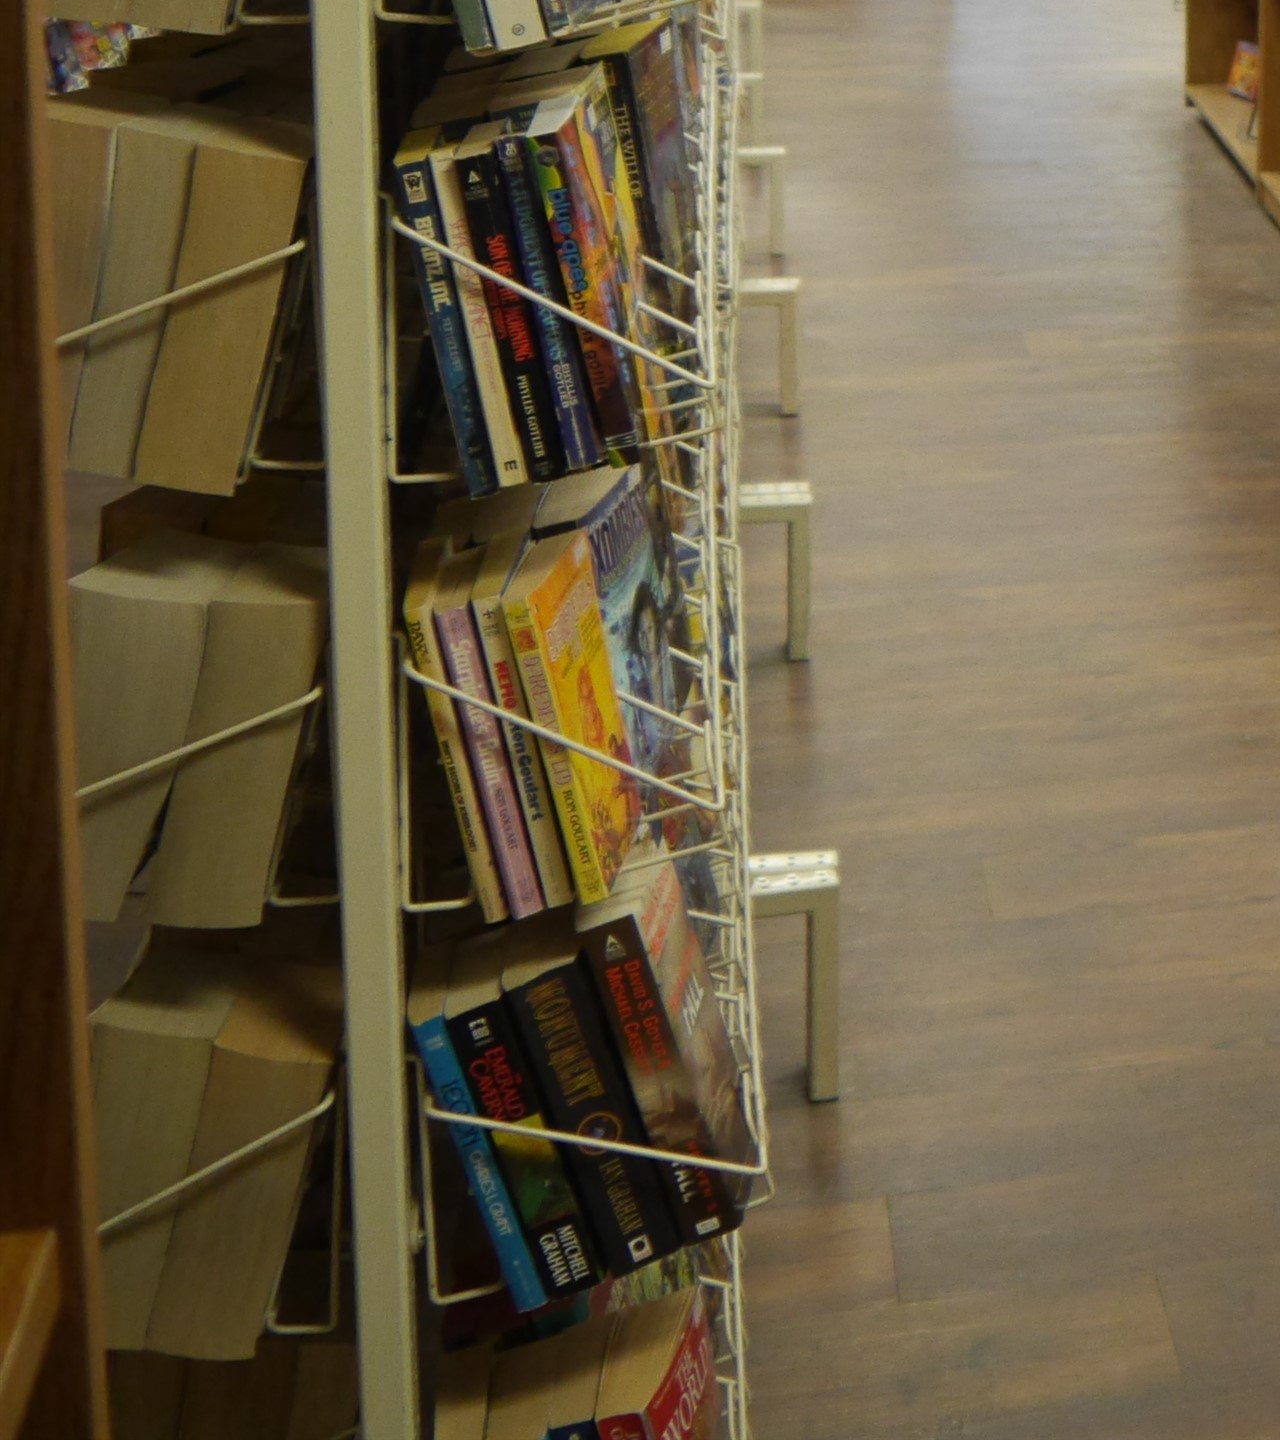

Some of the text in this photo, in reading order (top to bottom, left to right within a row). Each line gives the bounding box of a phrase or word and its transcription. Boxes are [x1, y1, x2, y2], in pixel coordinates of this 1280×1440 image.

[548, 189, 573, 233] blue
[539, 1233, 571, 1288] GRAHAM
[556, 1224, 590, 1282] MITCHELL
